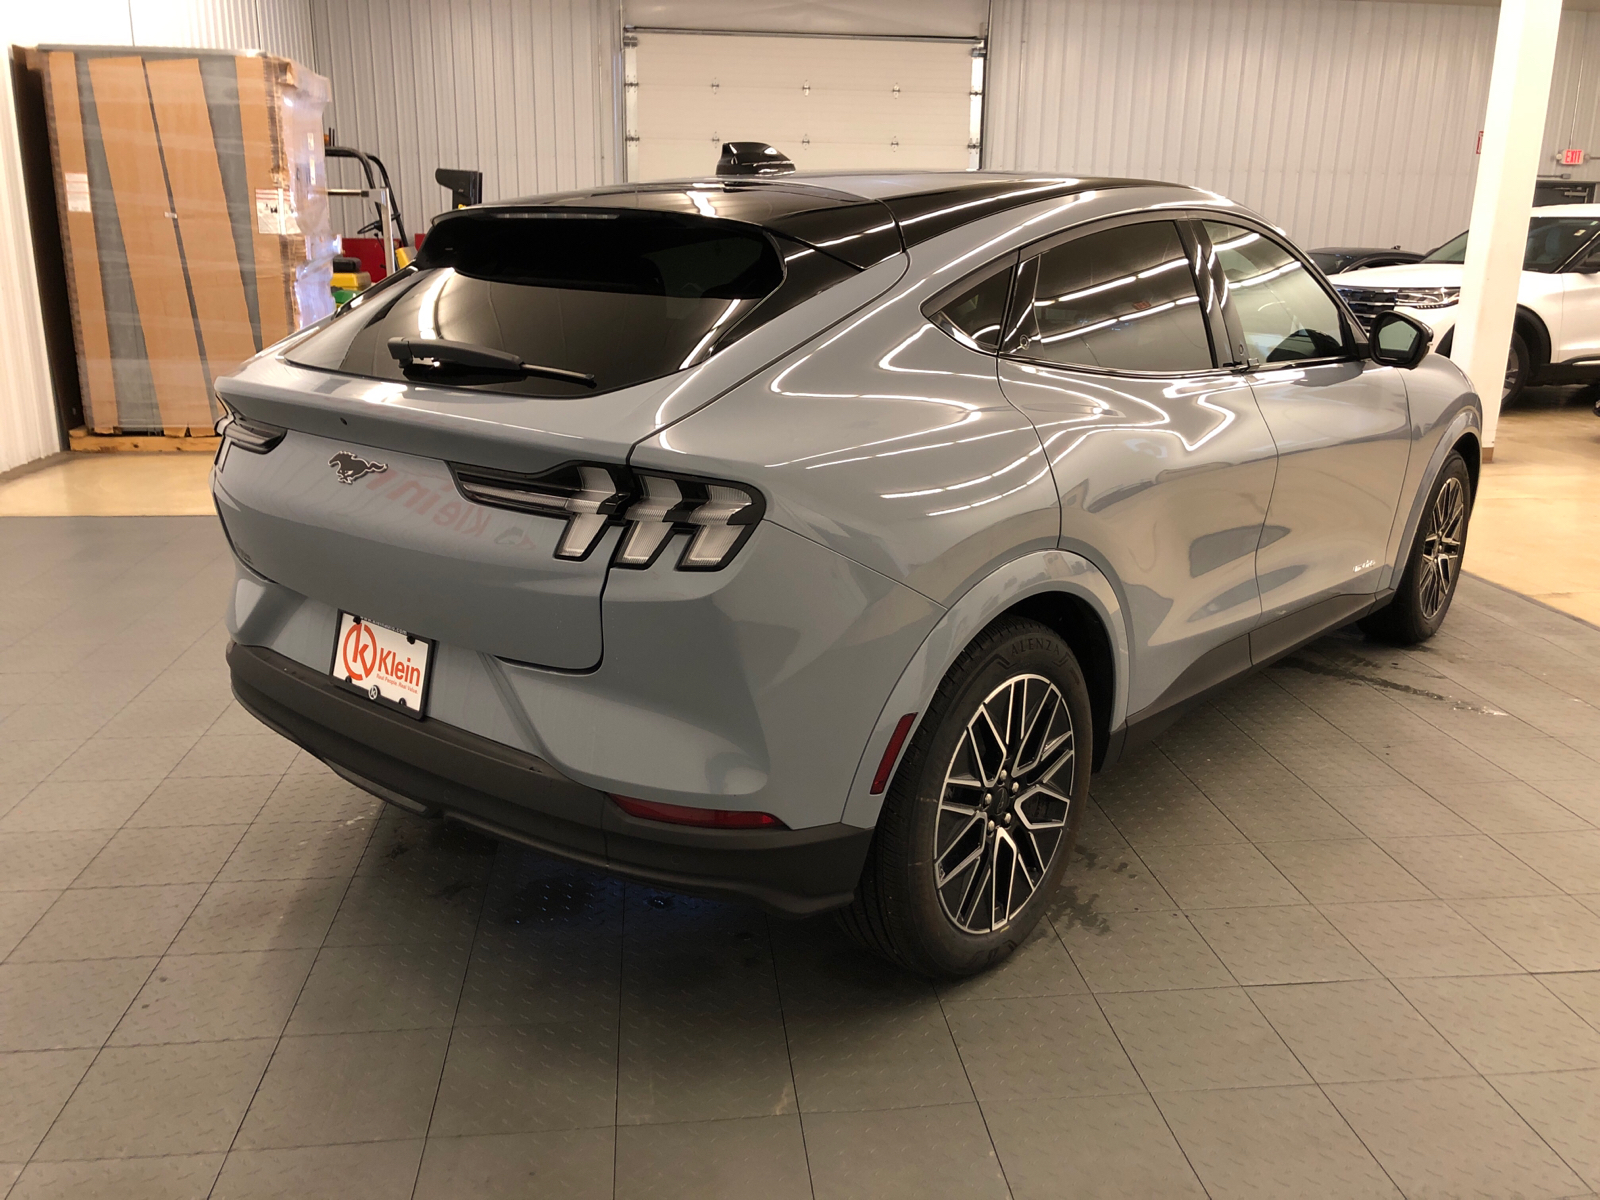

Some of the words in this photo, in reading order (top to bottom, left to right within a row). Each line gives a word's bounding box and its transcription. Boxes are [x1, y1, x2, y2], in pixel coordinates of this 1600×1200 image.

[1565, 150, 1582, 163] EXIT
[1011, 637, 1061, 656] ALENZA
[377, 647, 421, 687] Klein
